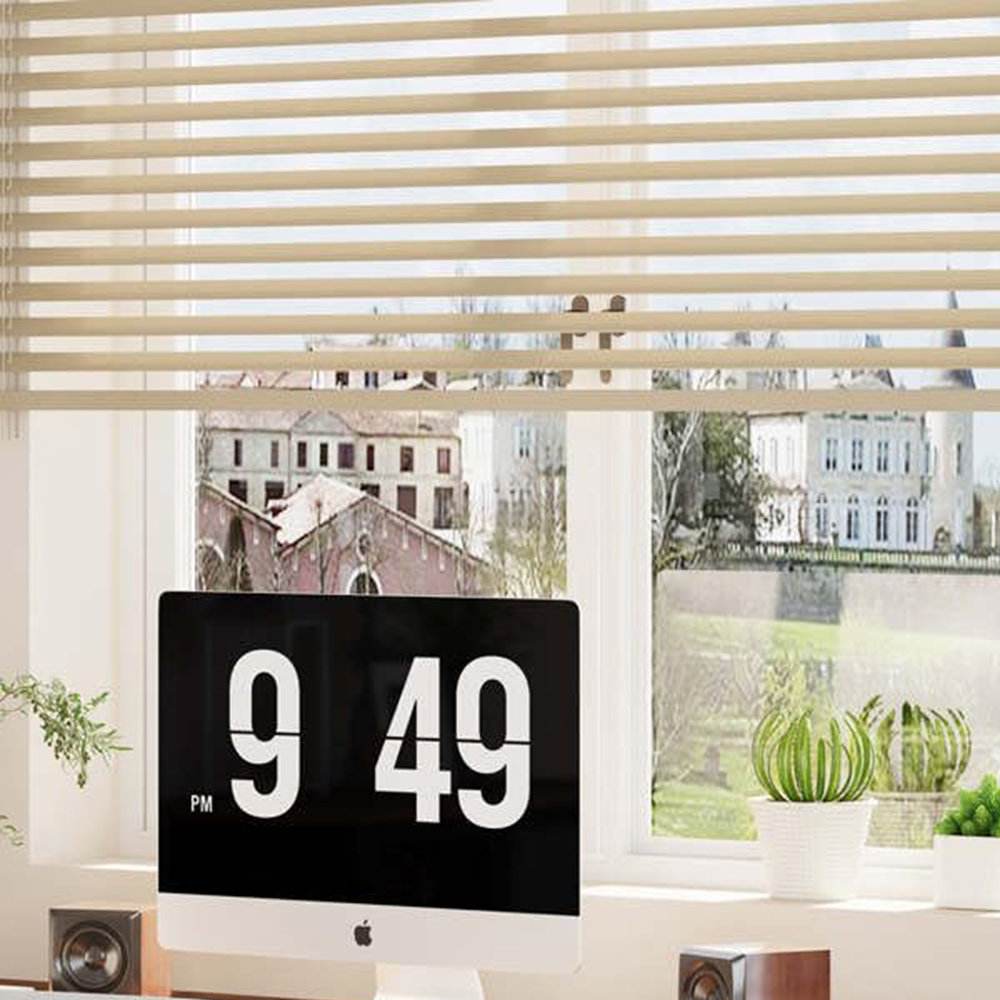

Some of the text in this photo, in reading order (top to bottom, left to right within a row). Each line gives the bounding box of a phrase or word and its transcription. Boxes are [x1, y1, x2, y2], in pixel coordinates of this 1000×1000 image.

[229, 649, 532, 830] 9 49
[190, 794, 214, 813] PM
